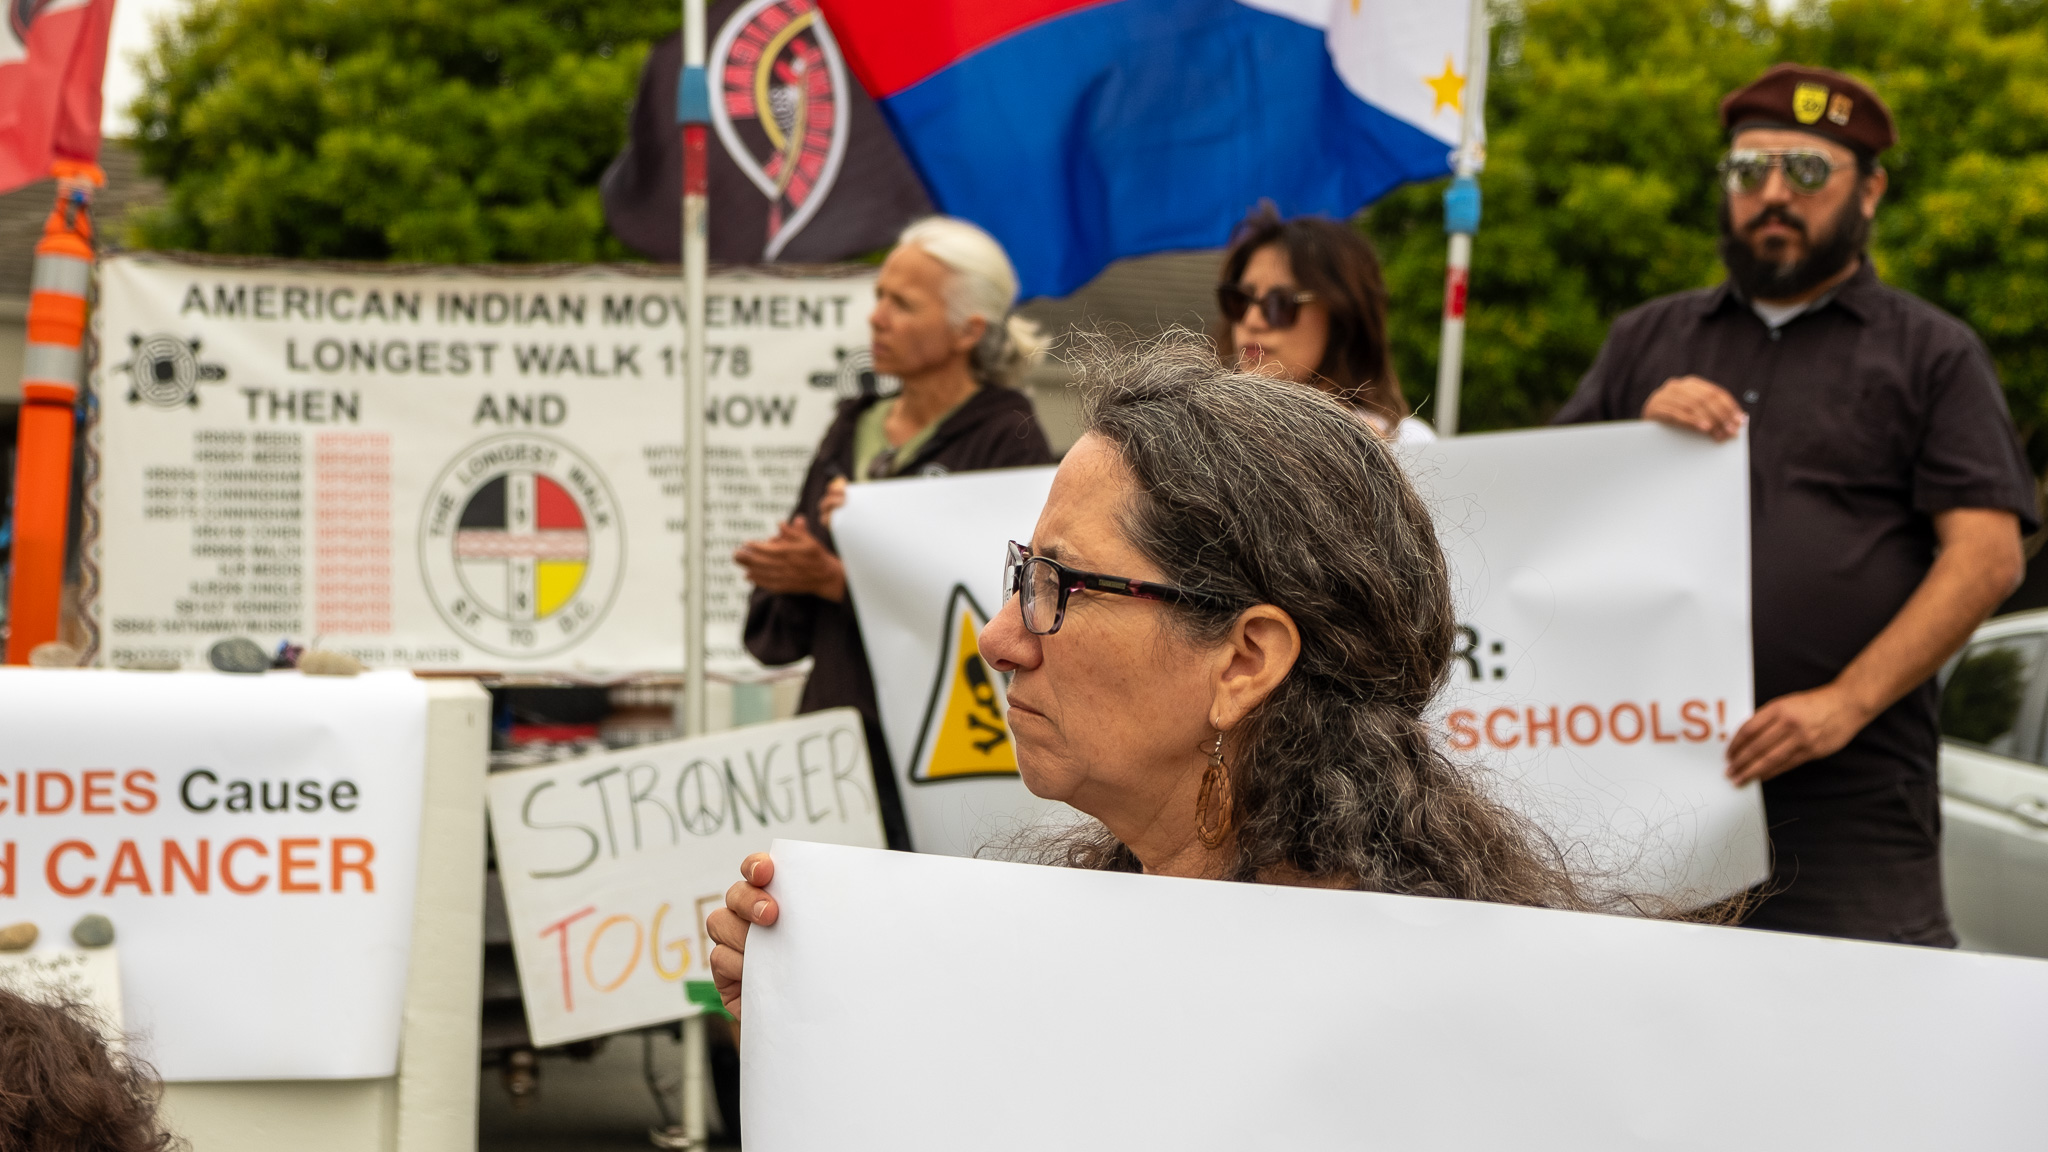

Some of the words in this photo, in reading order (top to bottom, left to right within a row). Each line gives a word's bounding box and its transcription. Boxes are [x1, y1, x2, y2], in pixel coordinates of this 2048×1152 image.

[181, 285, 420, 321] AMERICAN
[436, 290, 586, 324] INDIAN
[286, 339, 498, 376] LONGEST
[514, 344, 641, 377] WALK
[242, 388, 360, 423] THEN
[473, 393, 567, 426] AND
[1446, 699, 1728, 751] SCHOOLS!
[179, 768, 359, 814] Cause
[521, 724, 873, 880] STRONGER
[44, 838, 376, 898] CANCER
